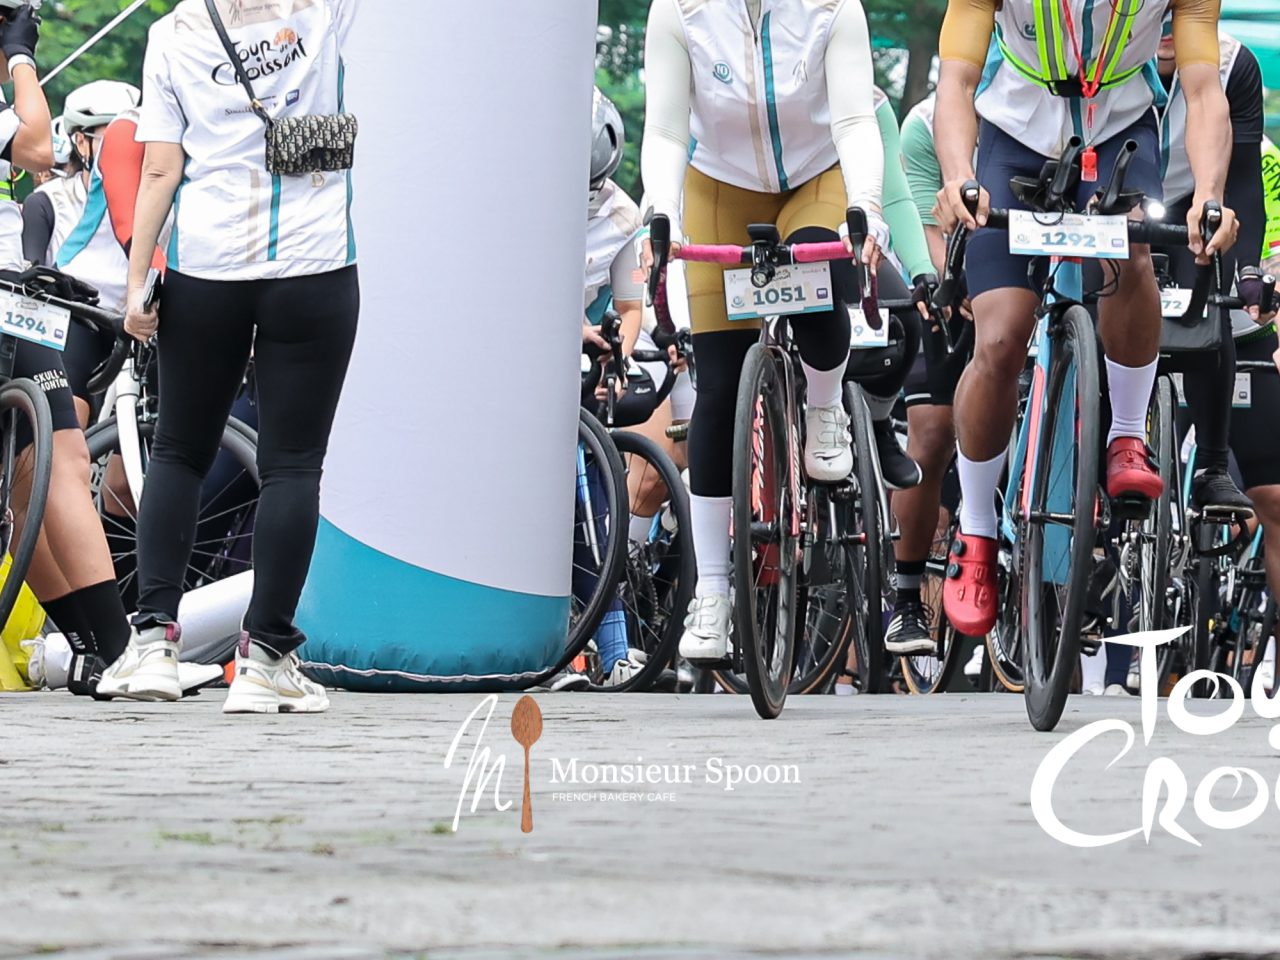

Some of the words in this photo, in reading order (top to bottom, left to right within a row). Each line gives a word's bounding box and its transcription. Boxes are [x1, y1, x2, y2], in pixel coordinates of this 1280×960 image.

[211, 35, 308, 85] Coissant
[1041, 231, 1097, 248] 1292
[753, 285, 806, 306] 1051
[4, 311, 47, 335] 1294
